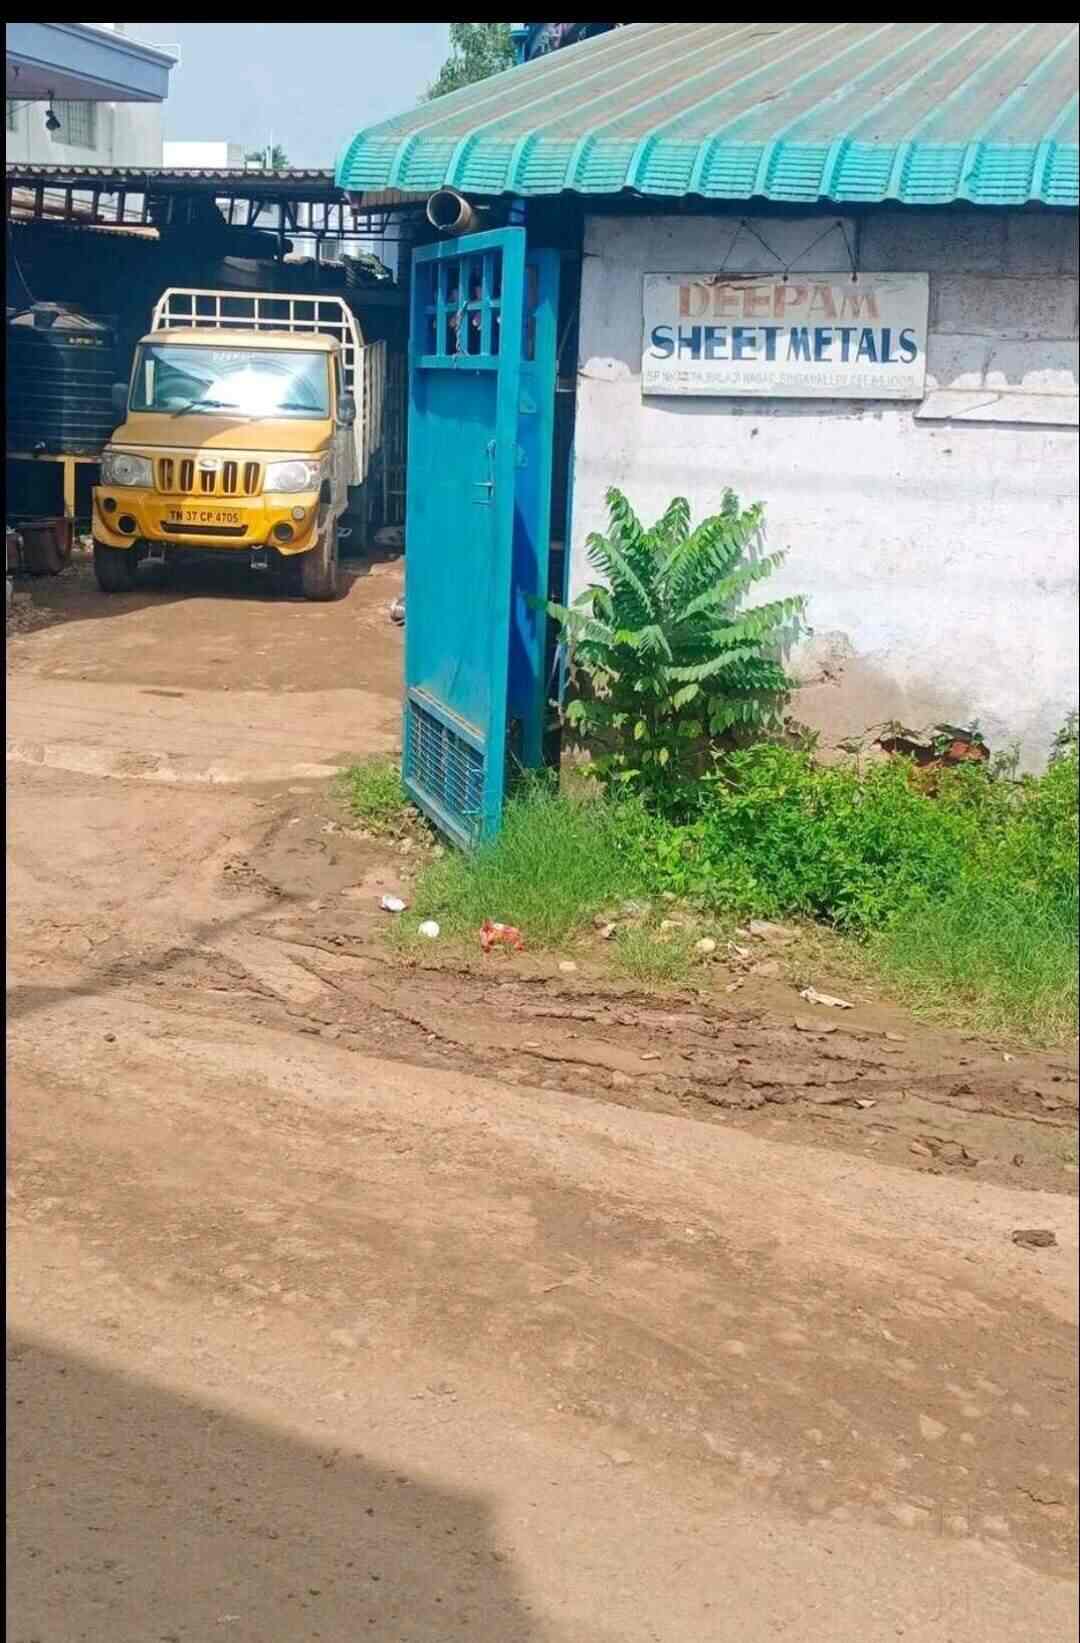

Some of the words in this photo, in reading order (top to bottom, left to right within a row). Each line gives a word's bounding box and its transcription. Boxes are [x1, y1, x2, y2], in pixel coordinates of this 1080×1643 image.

[678, 283, 880, 320] DEEPAM
[650, 325, 784, 361] SHEET
[787, 326, 918, 364] METALS
[170, 510, 183, 521] TN
[186, 511, 197, 521] 37
